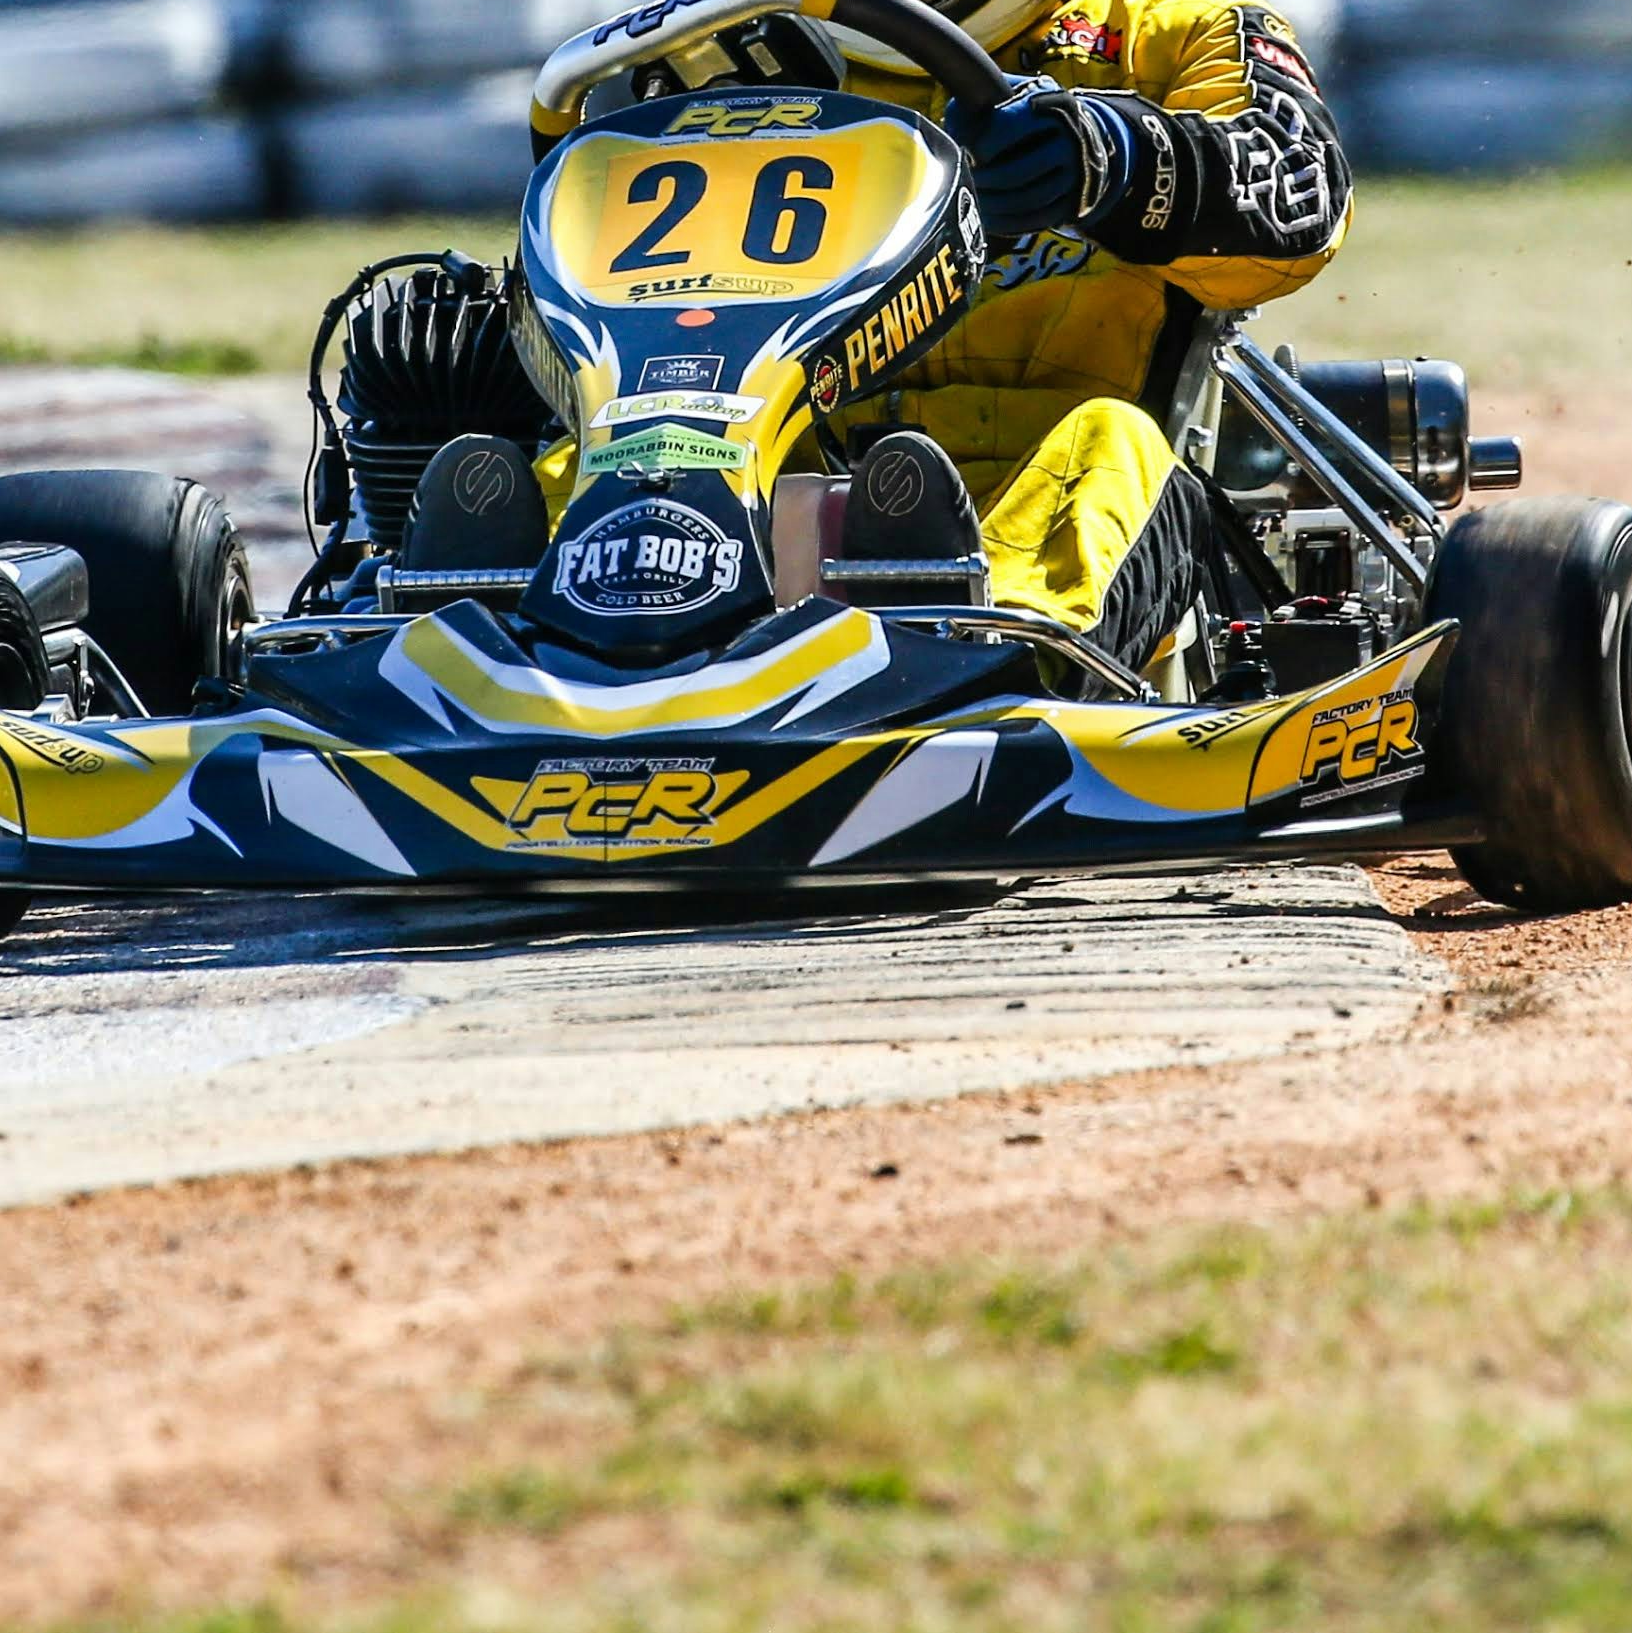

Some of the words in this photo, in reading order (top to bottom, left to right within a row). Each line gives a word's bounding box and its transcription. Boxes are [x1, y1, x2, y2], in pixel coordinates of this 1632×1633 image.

[664, 102, 822, 136] PCR
[1142, 114, 1175, 230] sparco
[609, 155, 834, 272] 26
[845, 244, 963, 391] PENRITE
[810, 363, 843, 402] PENRITE
[591, 441, 685, 465] MOORABBIN
[688, 445, 738, 461] SIGNS
[595, 507, 710, 540] HAMBURGERS
[559, 538, 630, 589] FAT
[634, 534, 738, 588] BOB'S
[643, 572, 685, 585] GRILL
[596, 593, 637, 605] COLD
[642, 591, 685, 604] BEER
[1313, 698, 1373, 724] FACTORY
[1378, 688, 1414, 706] TEAM
[1300, 699, 1421, 786] PCR
[538, 758, 644, 771] FACTORY
[646, 757, 715, 771] TEAM
[507, 770, 716, 836] PCR
